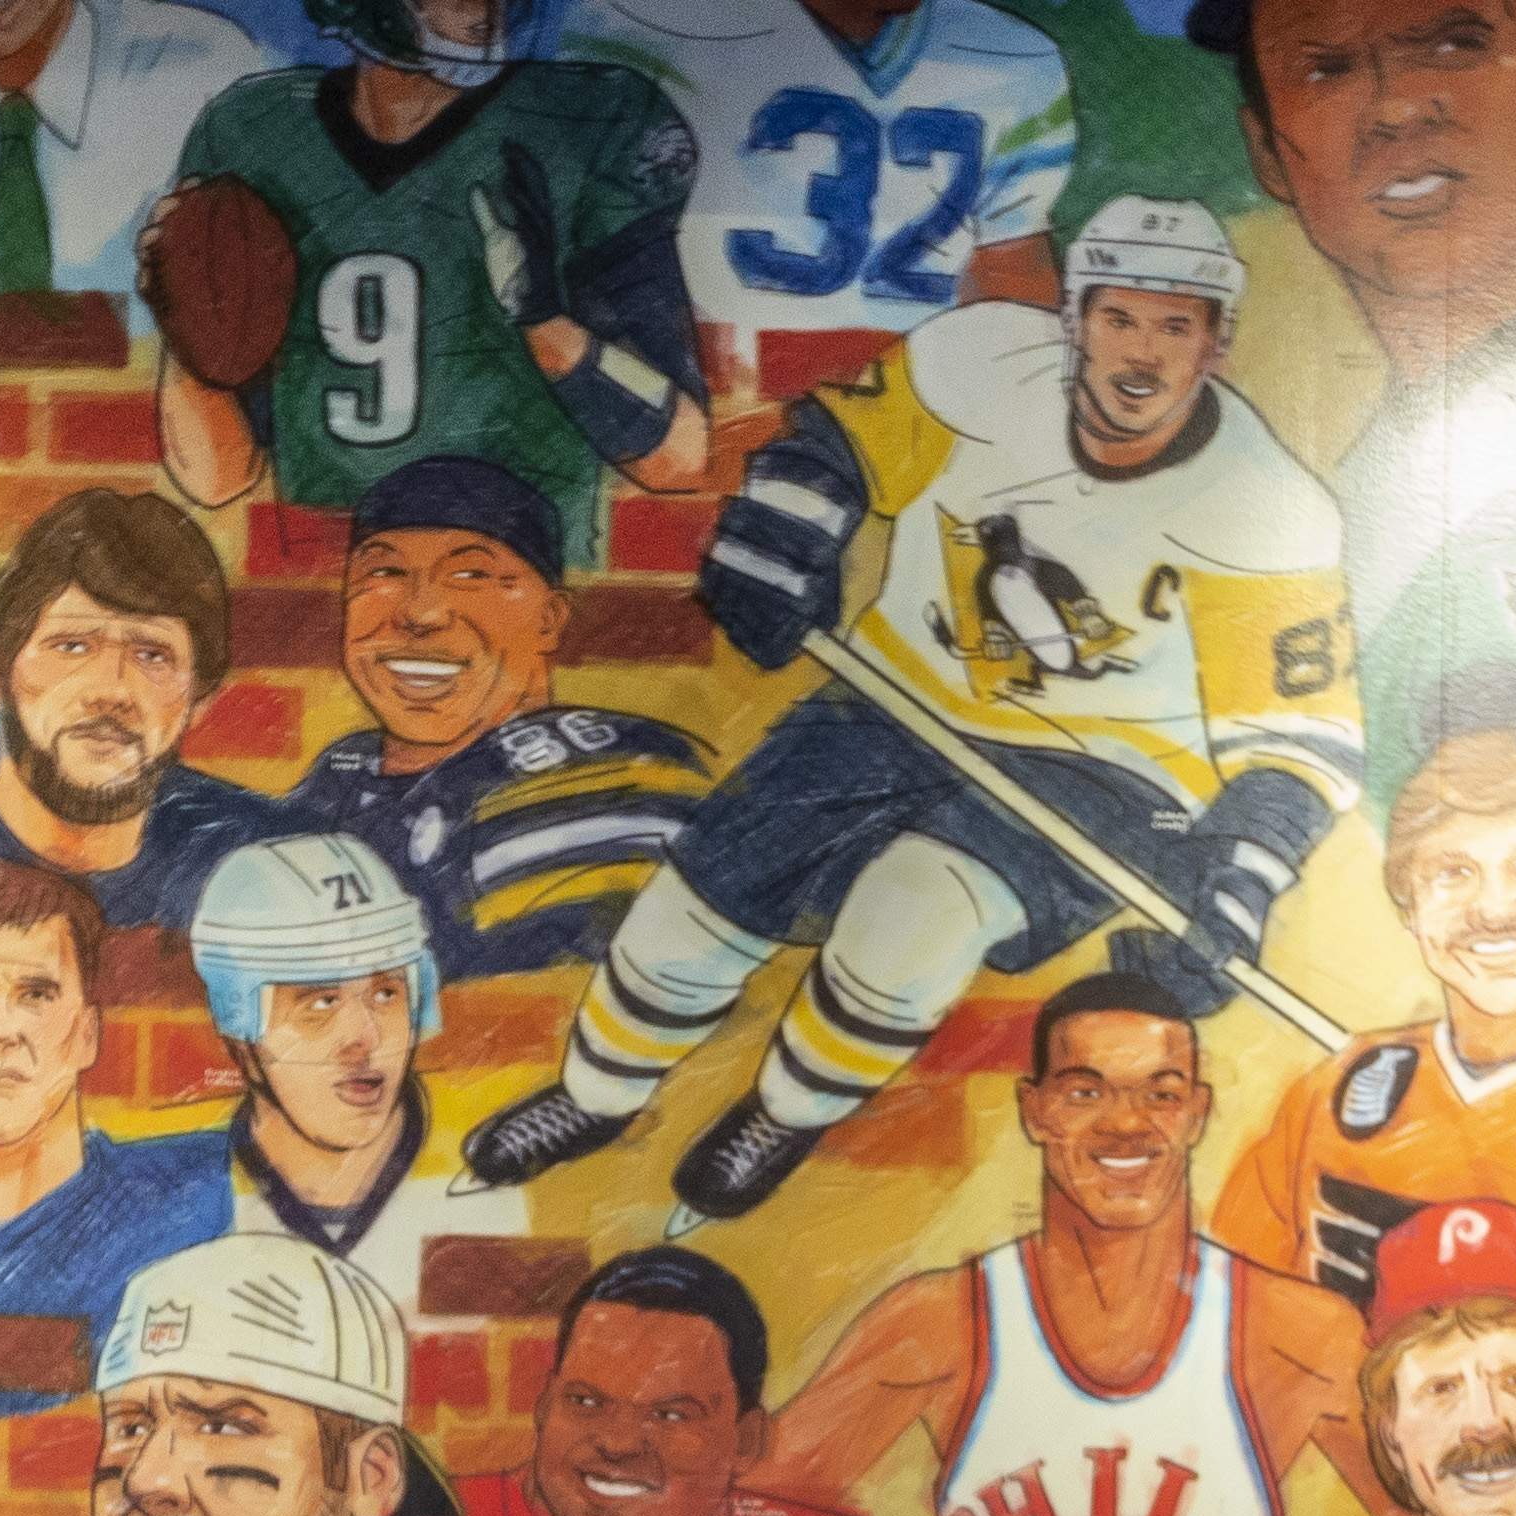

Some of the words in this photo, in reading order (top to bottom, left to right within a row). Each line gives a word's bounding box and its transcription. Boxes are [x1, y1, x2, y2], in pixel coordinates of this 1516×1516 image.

[725, 86, 986, 306] 32
[318, 251, 420, 447] 9
[1140, 562, 1181, 622] C
[498, 711, 618, 771] 86
[322, 871, 373, 910] 71
[1438, 1208, 1490, 1264] P
